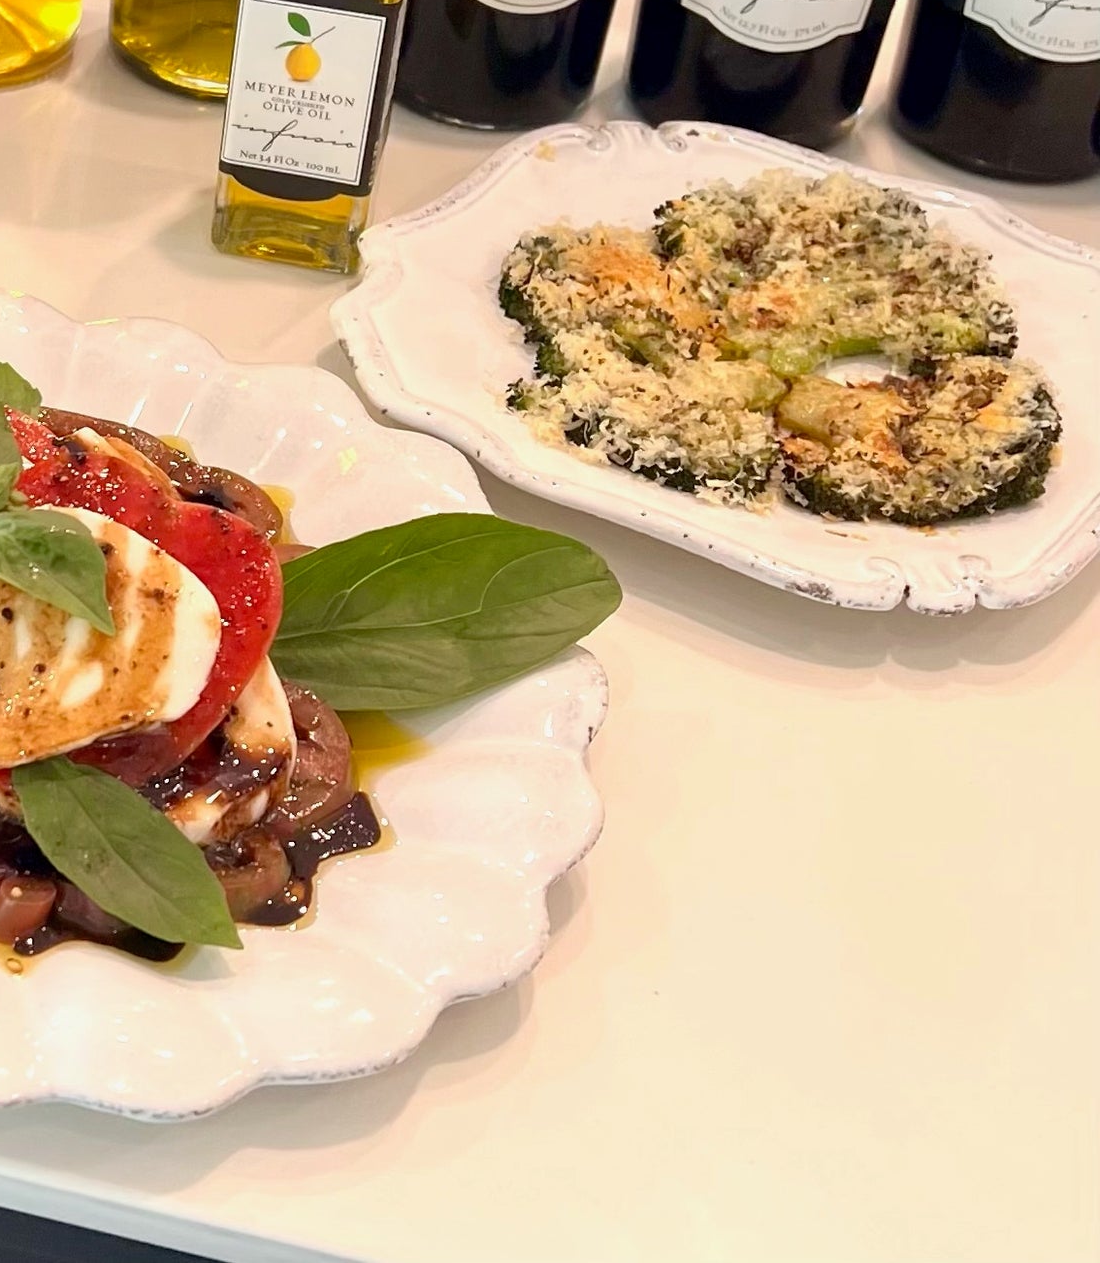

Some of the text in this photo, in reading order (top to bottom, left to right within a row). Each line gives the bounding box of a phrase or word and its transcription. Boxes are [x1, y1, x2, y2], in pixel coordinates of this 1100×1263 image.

[245, 80, 355, 107] MEYER LEMON
[263, 101, 331, 121] OLIVE OIL
[240, 149, 257, 160] Net
[274, 155, 283, 164] Fl
[285, 157, 299, 167] Oz
[306, 162, 323, 171] 100
[325, 165, 340, 174] mL
